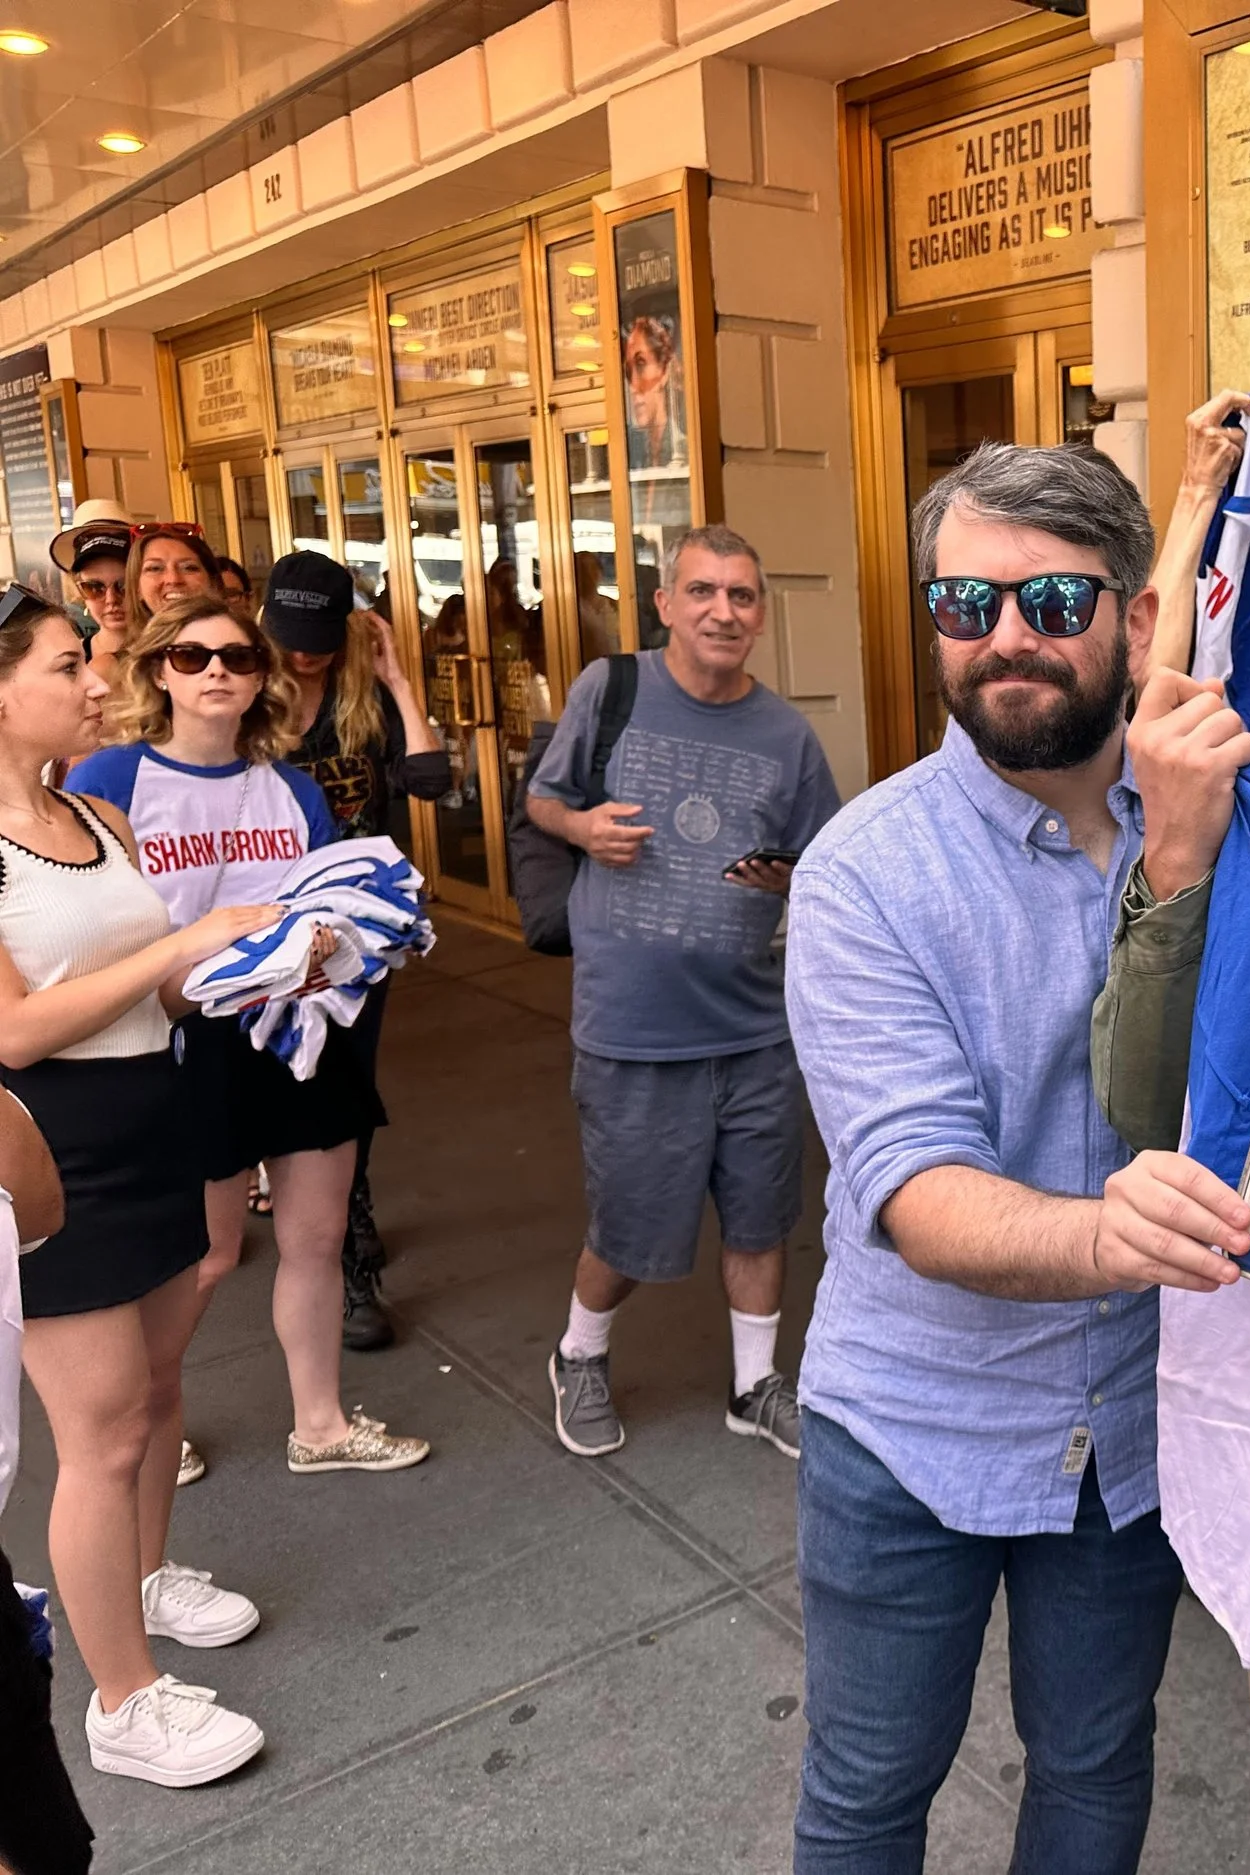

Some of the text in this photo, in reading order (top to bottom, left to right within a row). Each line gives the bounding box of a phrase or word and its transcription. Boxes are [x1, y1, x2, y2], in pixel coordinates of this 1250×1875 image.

[928, 176, 1008, 227] DELIVERS
[1016, 171, 1029, 205] A
[909, 221, 990, 270] ENGAGING
[999, 214, 1022, 250] AS
[1030, 207, 1046, 244] IT
[625, 256, 672, 291] DIAMOND
[144, 832, 219, 875] SHARK
